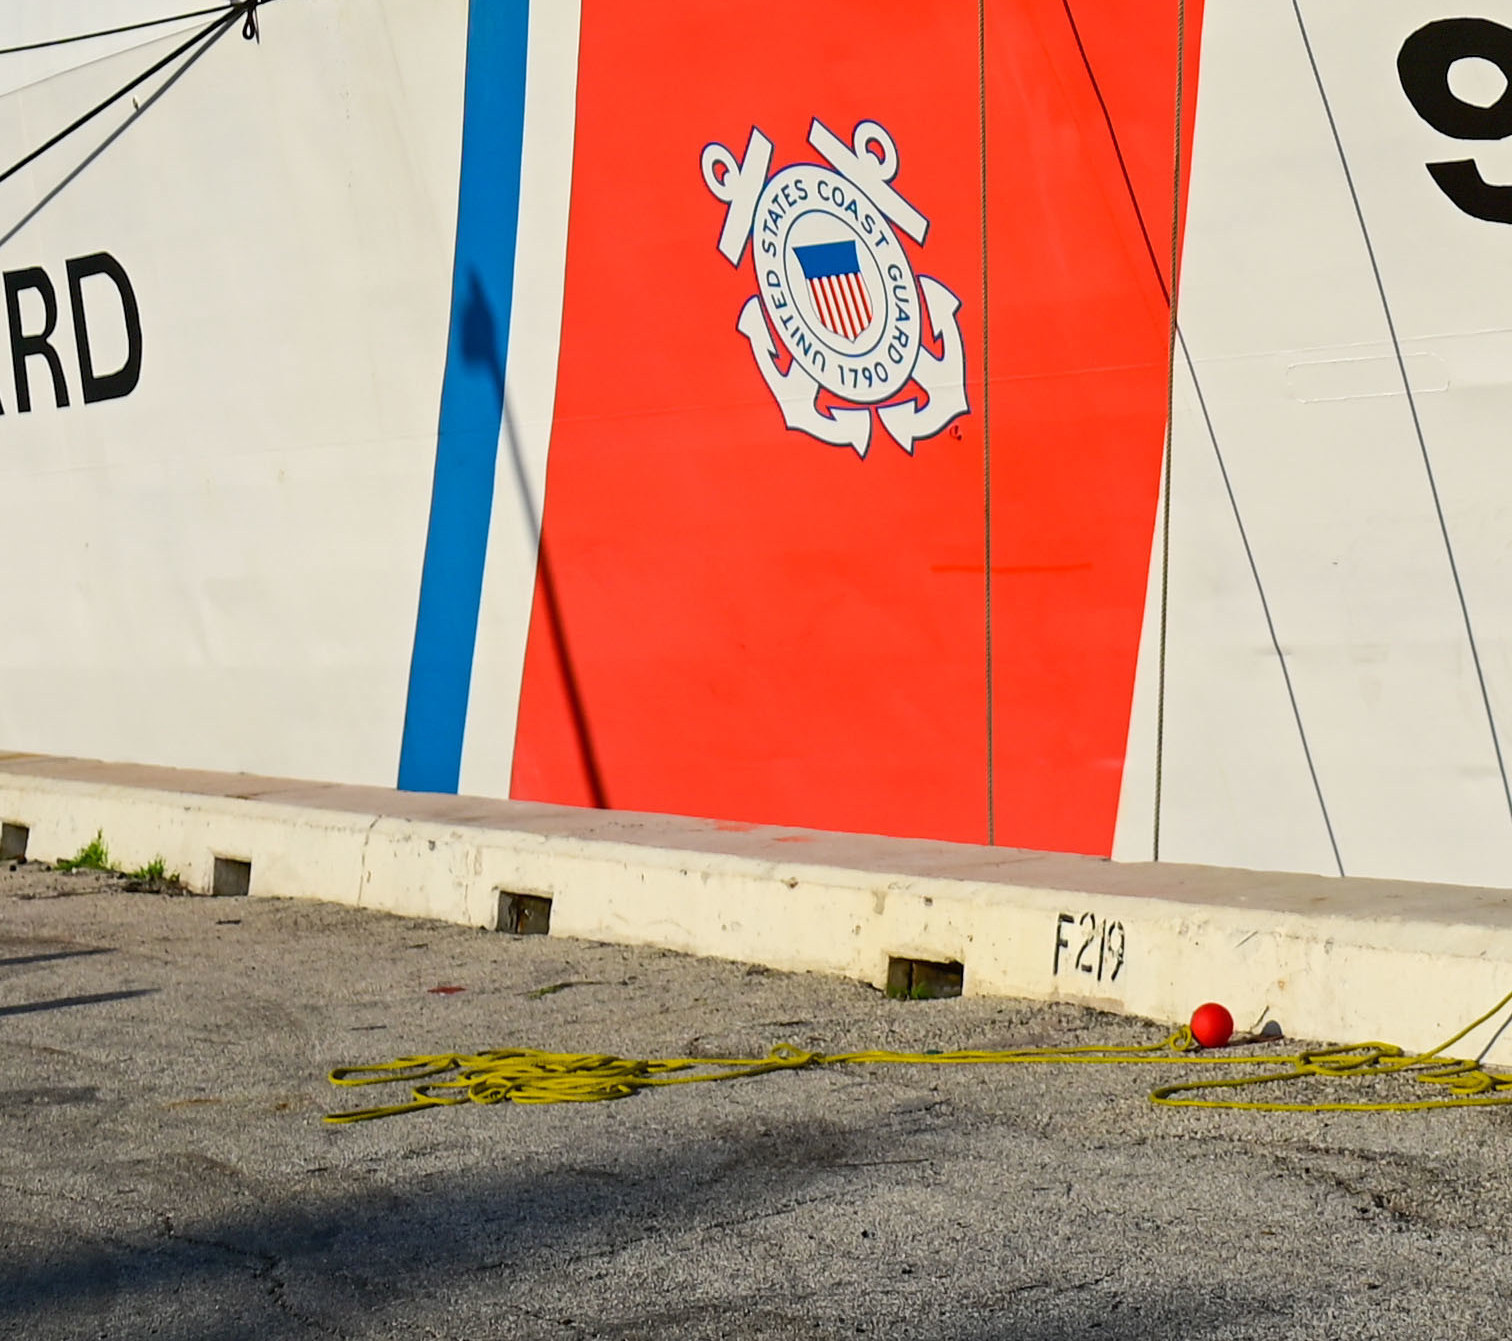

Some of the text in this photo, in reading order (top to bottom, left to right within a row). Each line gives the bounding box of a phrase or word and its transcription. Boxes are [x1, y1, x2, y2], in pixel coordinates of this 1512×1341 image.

[762, 179, 911, 373] UNITED STATES COAST GUARD
[838, 361, 889, 389] 1790
